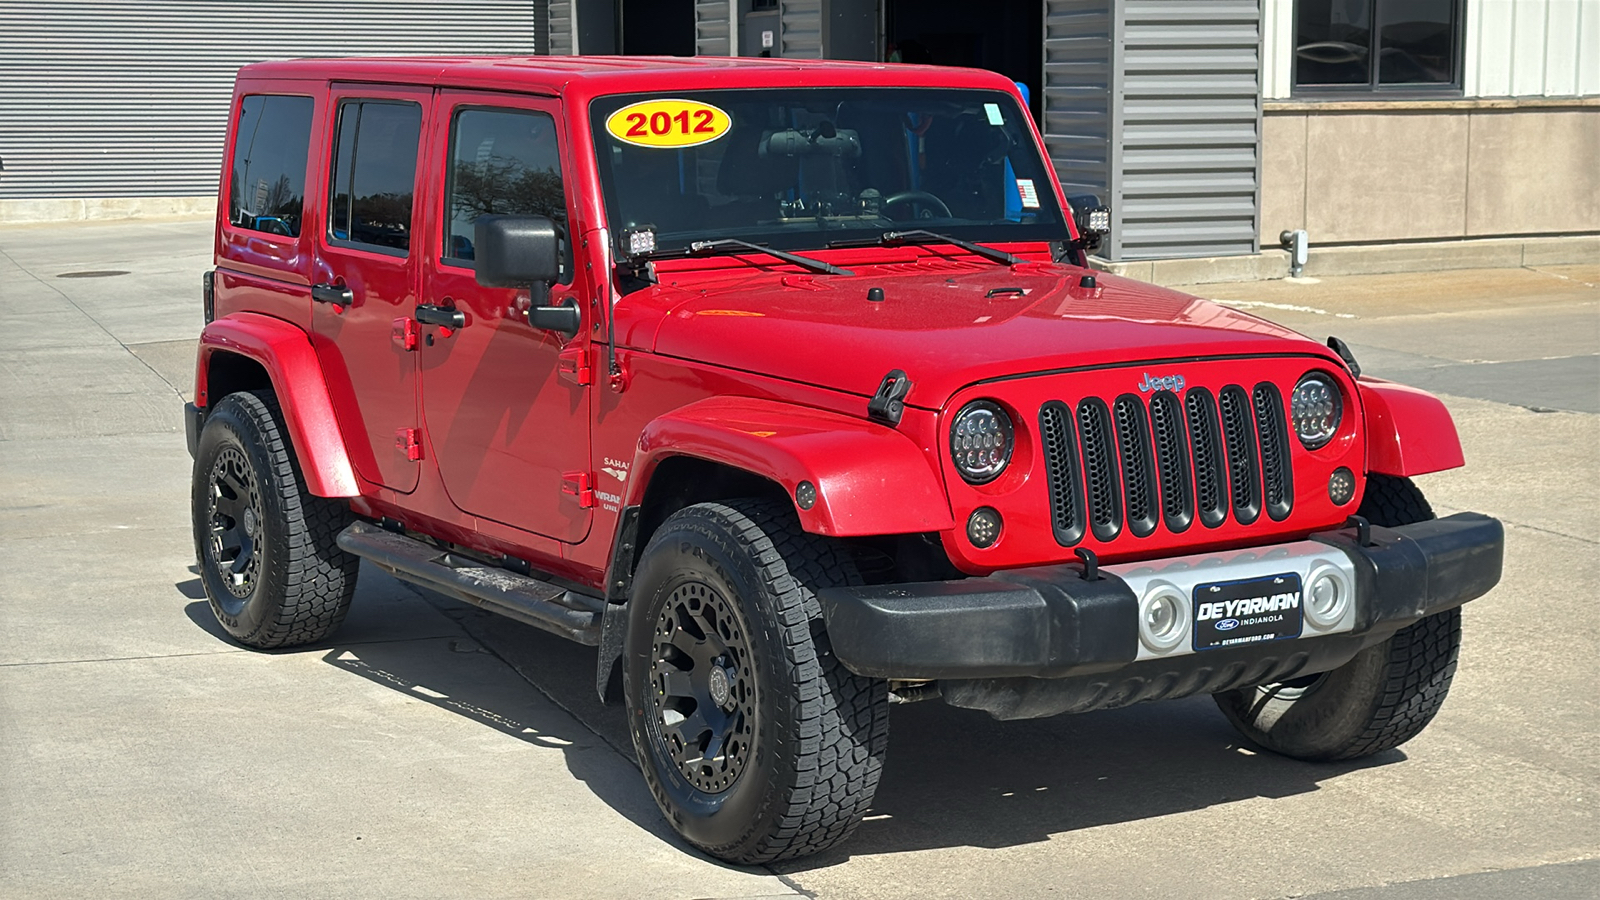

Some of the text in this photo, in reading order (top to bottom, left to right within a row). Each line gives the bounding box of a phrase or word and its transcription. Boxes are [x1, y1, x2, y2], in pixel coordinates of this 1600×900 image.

[626, 110, 715, 137] 2012
[1138, 373, 1185, 392] Jeep
[1197, 592, 1300, 620] DEYARMAN
[1241, 614, 1284, 626] INDIANOLA
